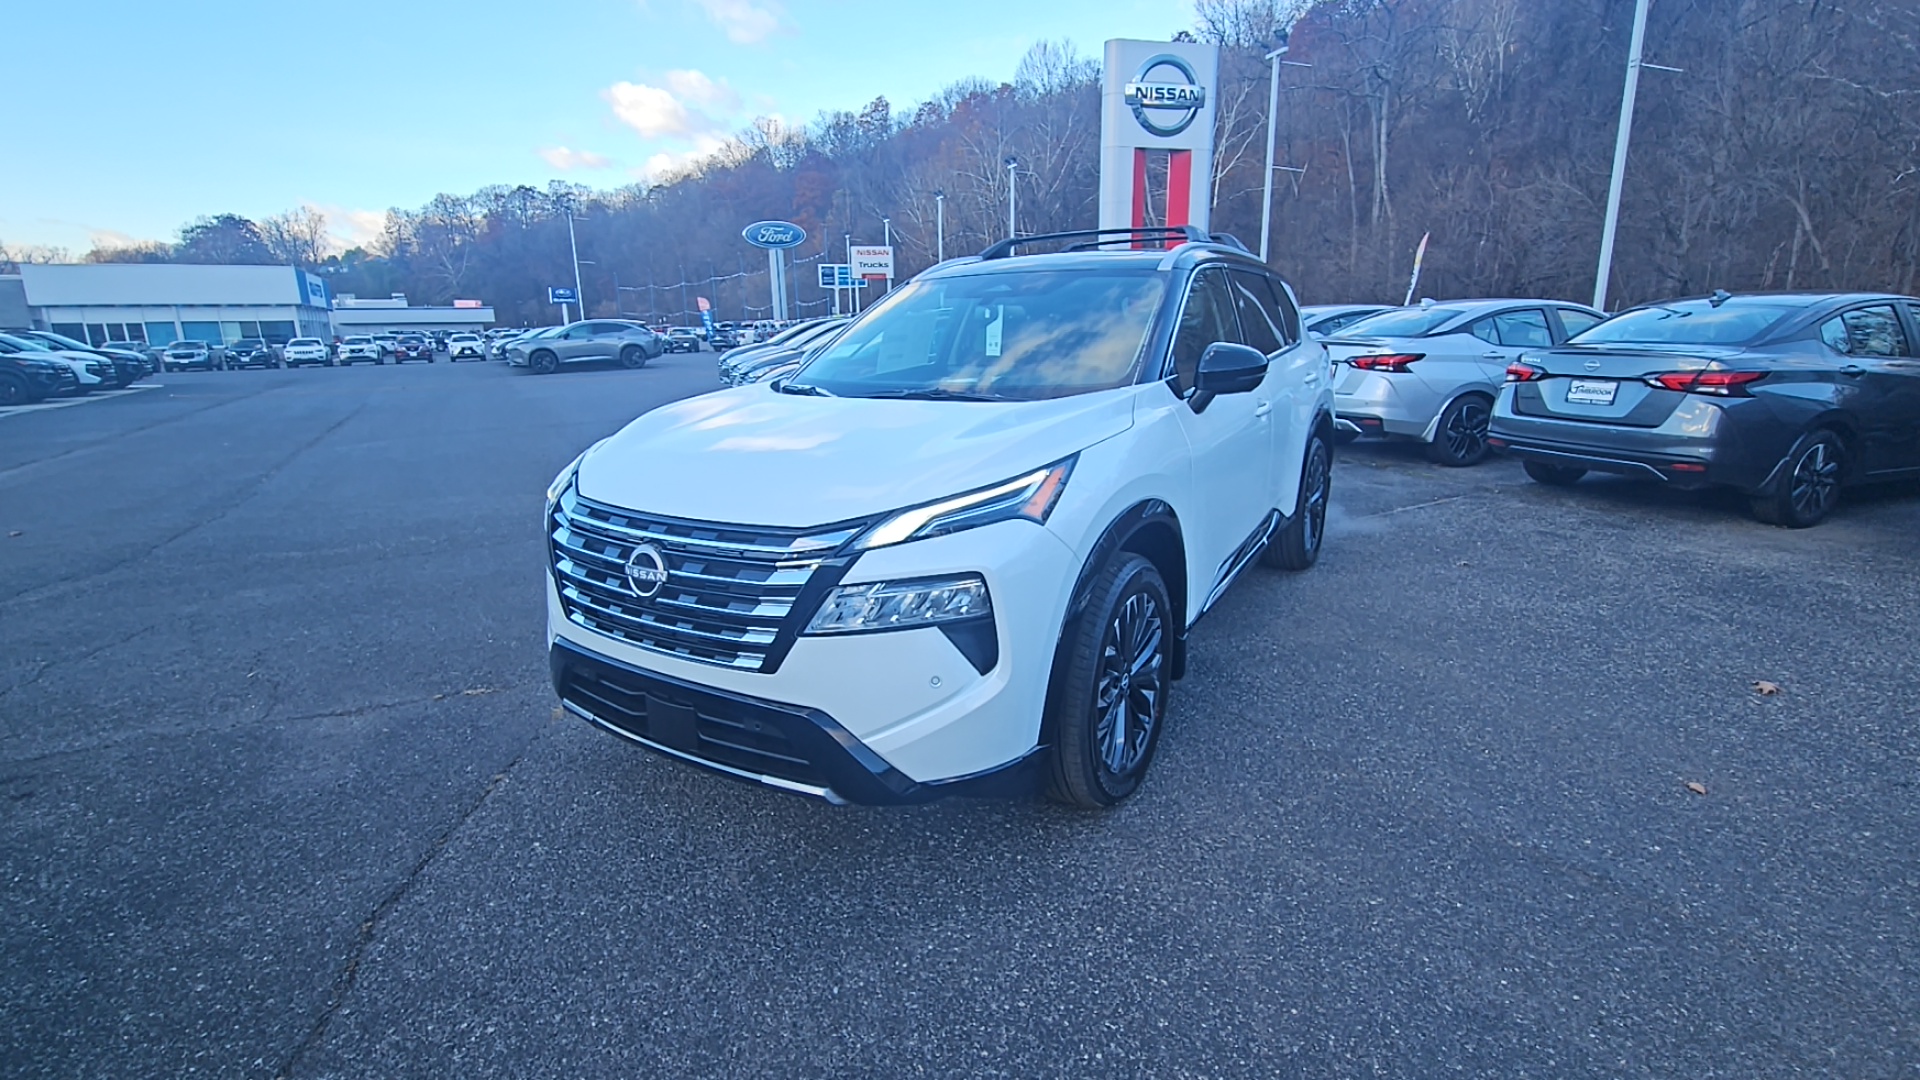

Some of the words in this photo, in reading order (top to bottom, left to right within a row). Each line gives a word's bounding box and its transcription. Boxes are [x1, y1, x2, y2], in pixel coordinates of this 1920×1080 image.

[1135, 86, 1200, 101] NISSAN
[758, 226, 793, 242] Ford
[625, 564, 668, 582] NISSAN
